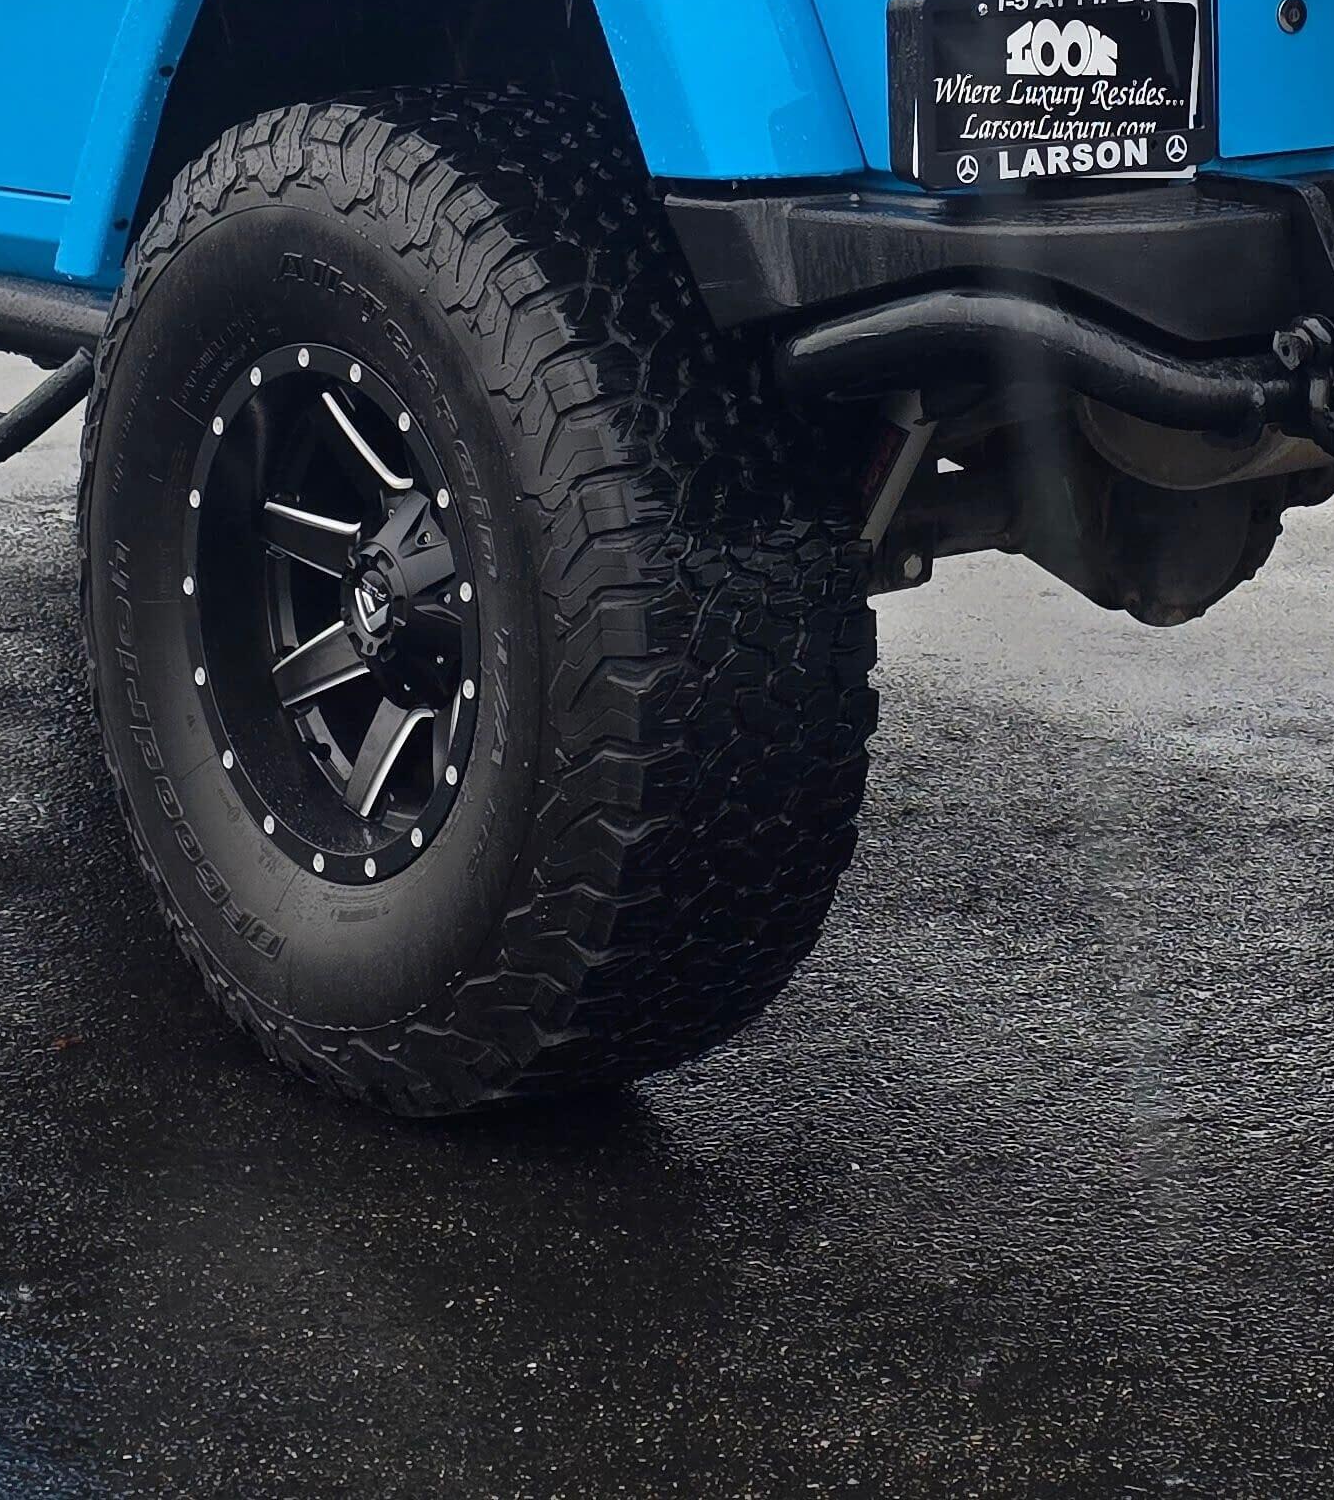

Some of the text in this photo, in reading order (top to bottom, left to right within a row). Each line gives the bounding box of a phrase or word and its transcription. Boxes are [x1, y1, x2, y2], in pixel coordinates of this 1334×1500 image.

[934, 73, 1002, 106] Where
[1006, 79, 1085, 116] Luxury
[998, 137, 1148, 180] LARSON
[108, 538, 288, 961] BFGoodrich
